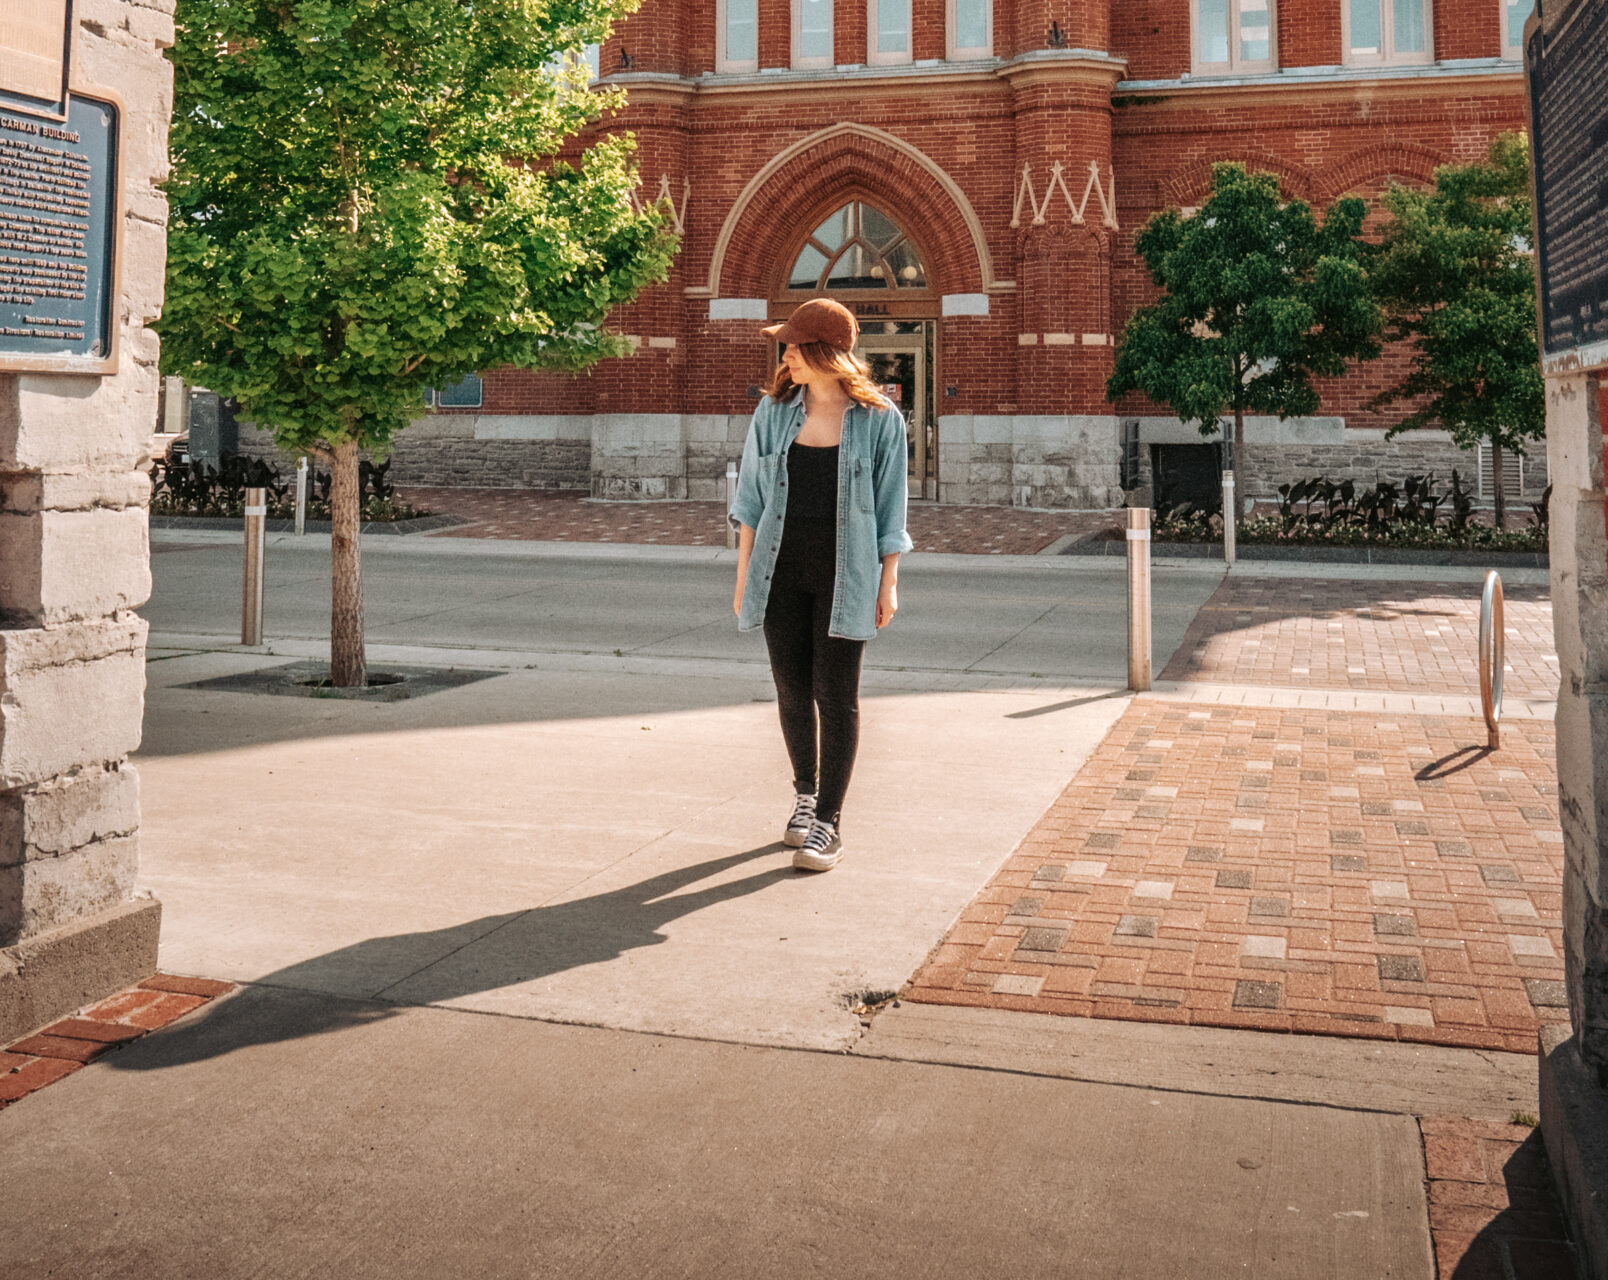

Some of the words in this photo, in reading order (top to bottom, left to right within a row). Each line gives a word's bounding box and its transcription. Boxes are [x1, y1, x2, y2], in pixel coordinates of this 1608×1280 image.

[1, 117, 39, 134] CARMAN
[42, 126, 81, 143] BUILDING
[855, 303, 890, 315] HALL
